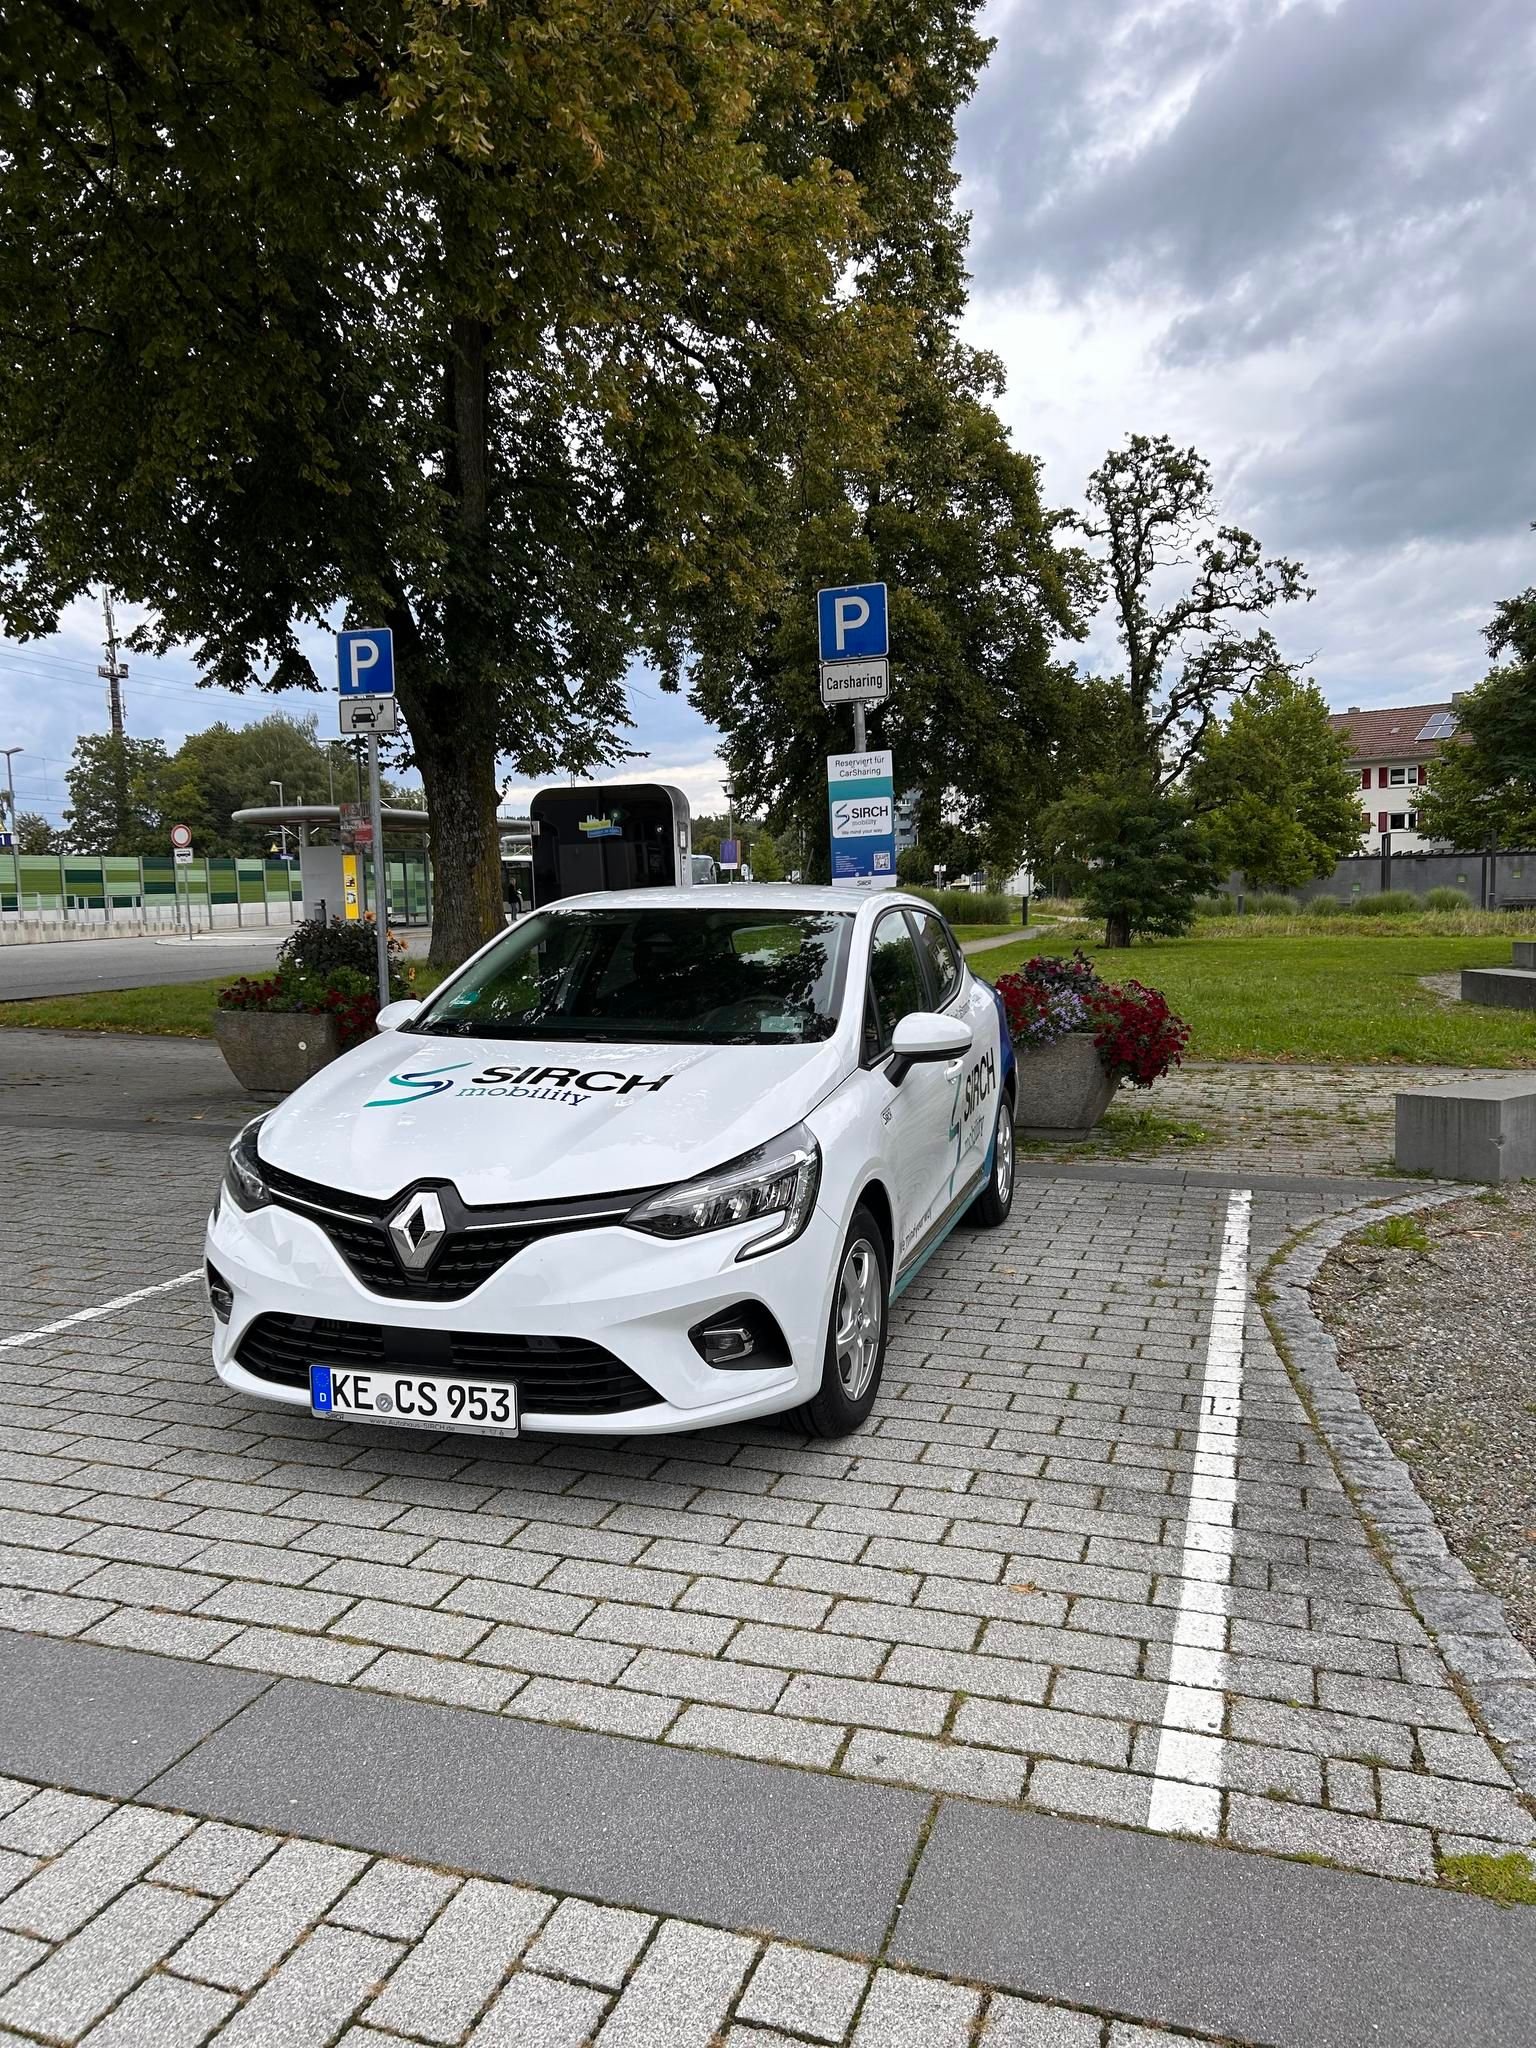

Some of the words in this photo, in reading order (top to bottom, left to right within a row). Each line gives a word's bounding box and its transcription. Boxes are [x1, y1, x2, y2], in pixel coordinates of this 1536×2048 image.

[835, 596, 870, 651] P
[349, 638, 379, 688] P
[826, 673, 883, 690] Carsharing
[835, 757, 873, 768] Reserviert
[874, 755, 885, 764] für
[839, 768, 881, 778] CarSharing
[851, 805, 889, 819] SIRCH
[471, 1066, 675, 1095] SIRCH
[963, 1047, 996, 1123] SIRCH
[454, 1085, 592, 1107] mobility
[319, 1392, 327, 1402] D
[332, 1373, 374, 1411] KE
[395, 1379, 438, 1417] CS
[447, 1384, 510, 1423] 953
